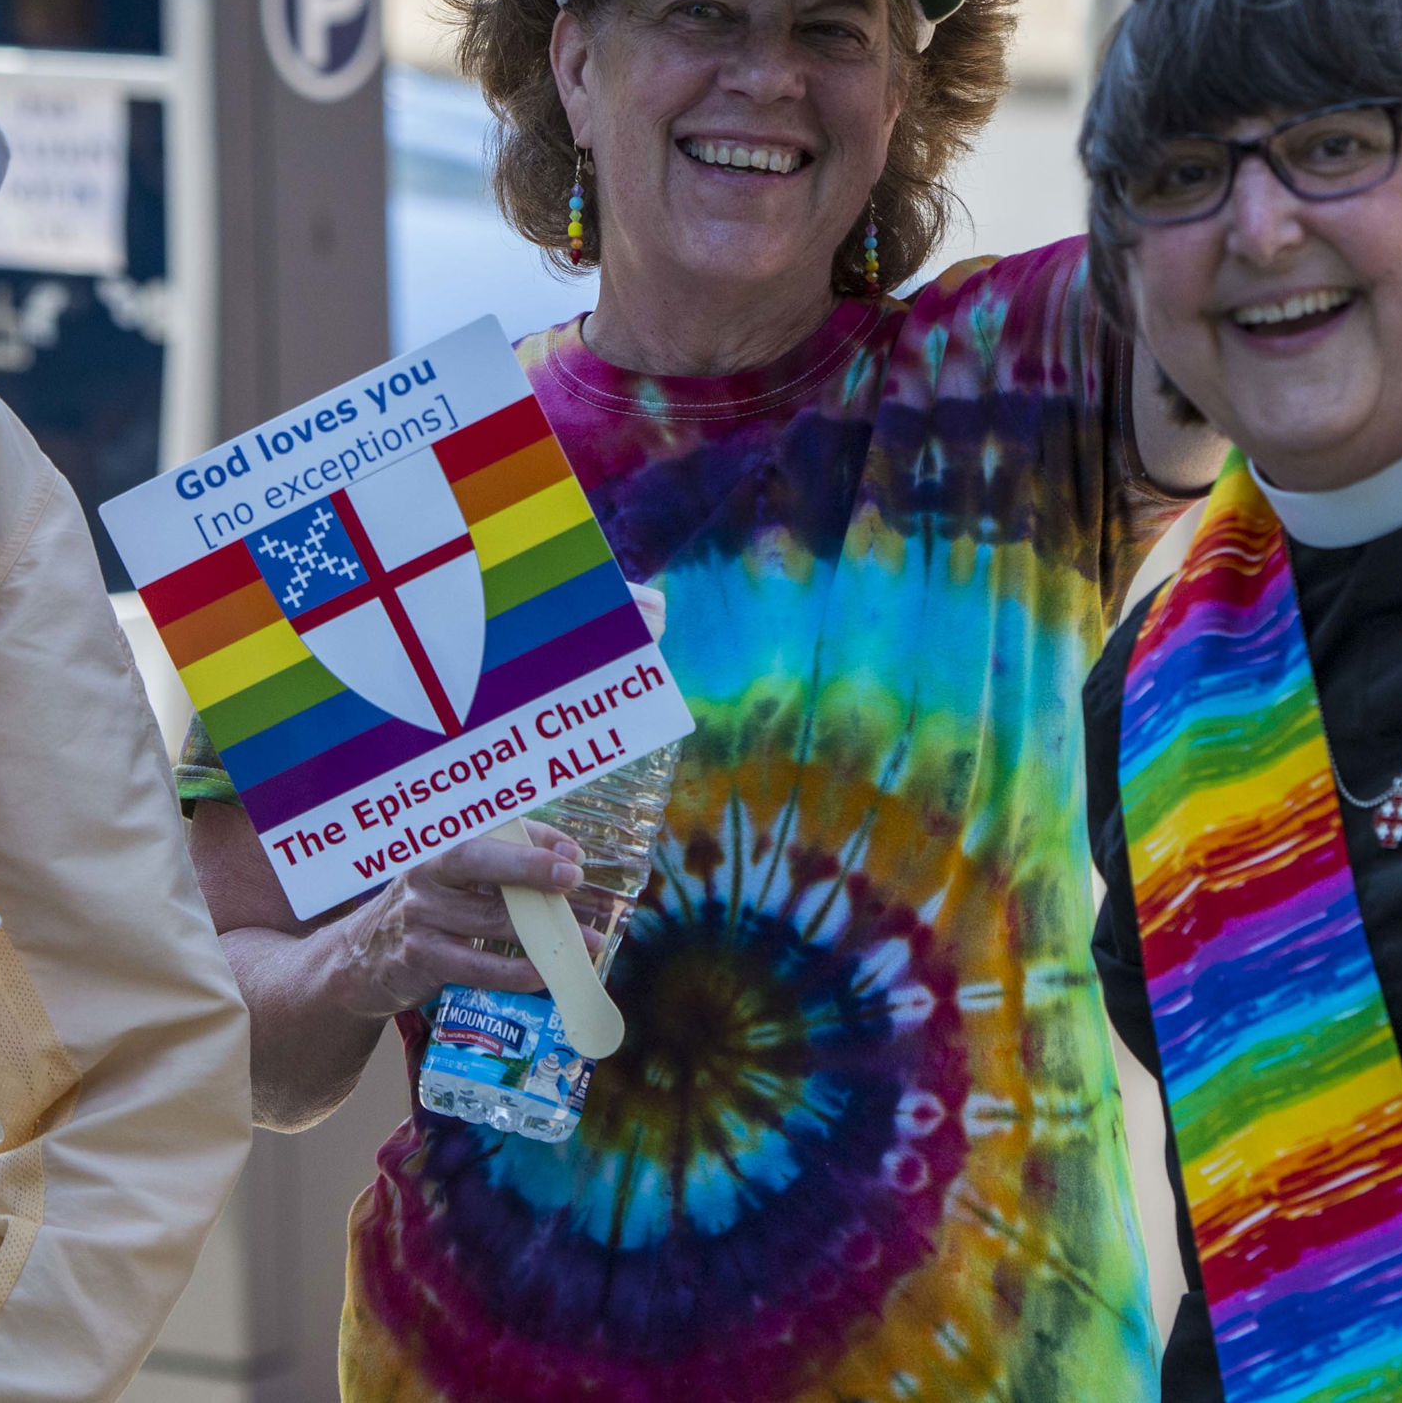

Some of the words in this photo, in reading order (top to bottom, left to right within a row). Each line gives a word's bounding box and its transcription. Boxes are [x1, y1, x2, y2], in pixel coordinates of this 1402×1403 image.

[175, 444, 252, 502] God
[254, 398, 359, 463] loves
[363, 358, 438, 415] you
[193, 501, 255, 550] [no
[264, 393, 459, 510] exceptions]
[272, 822, 347, 867] The
[351, 725, 528, 831] Episcopal
[535, 662, 665, 740] Church
[353, 777, 537, 880] welcomes
[547, 728, 627, 788] ALL!
[447, 1006, 520, 1045] MOUNTAIN
